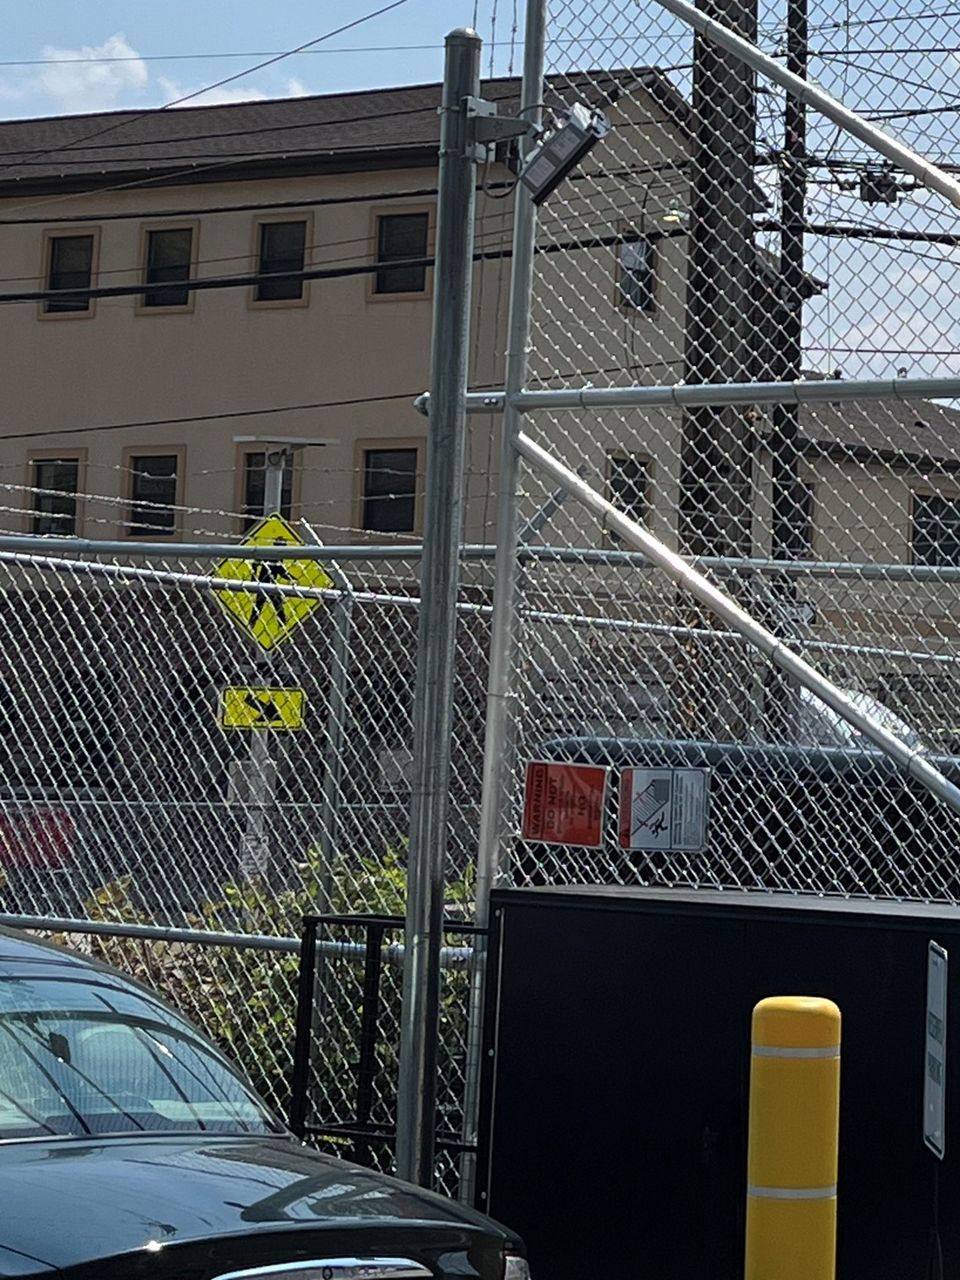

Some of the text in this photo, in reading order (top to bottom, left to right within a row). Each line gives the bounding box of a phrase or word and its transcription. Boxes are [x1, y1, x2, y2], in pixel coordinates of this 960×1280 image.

[532, 768, 544, 834] WARNING
[547, 777, 558, 829] DO NOT
[577, 795, 587, 816] NO
